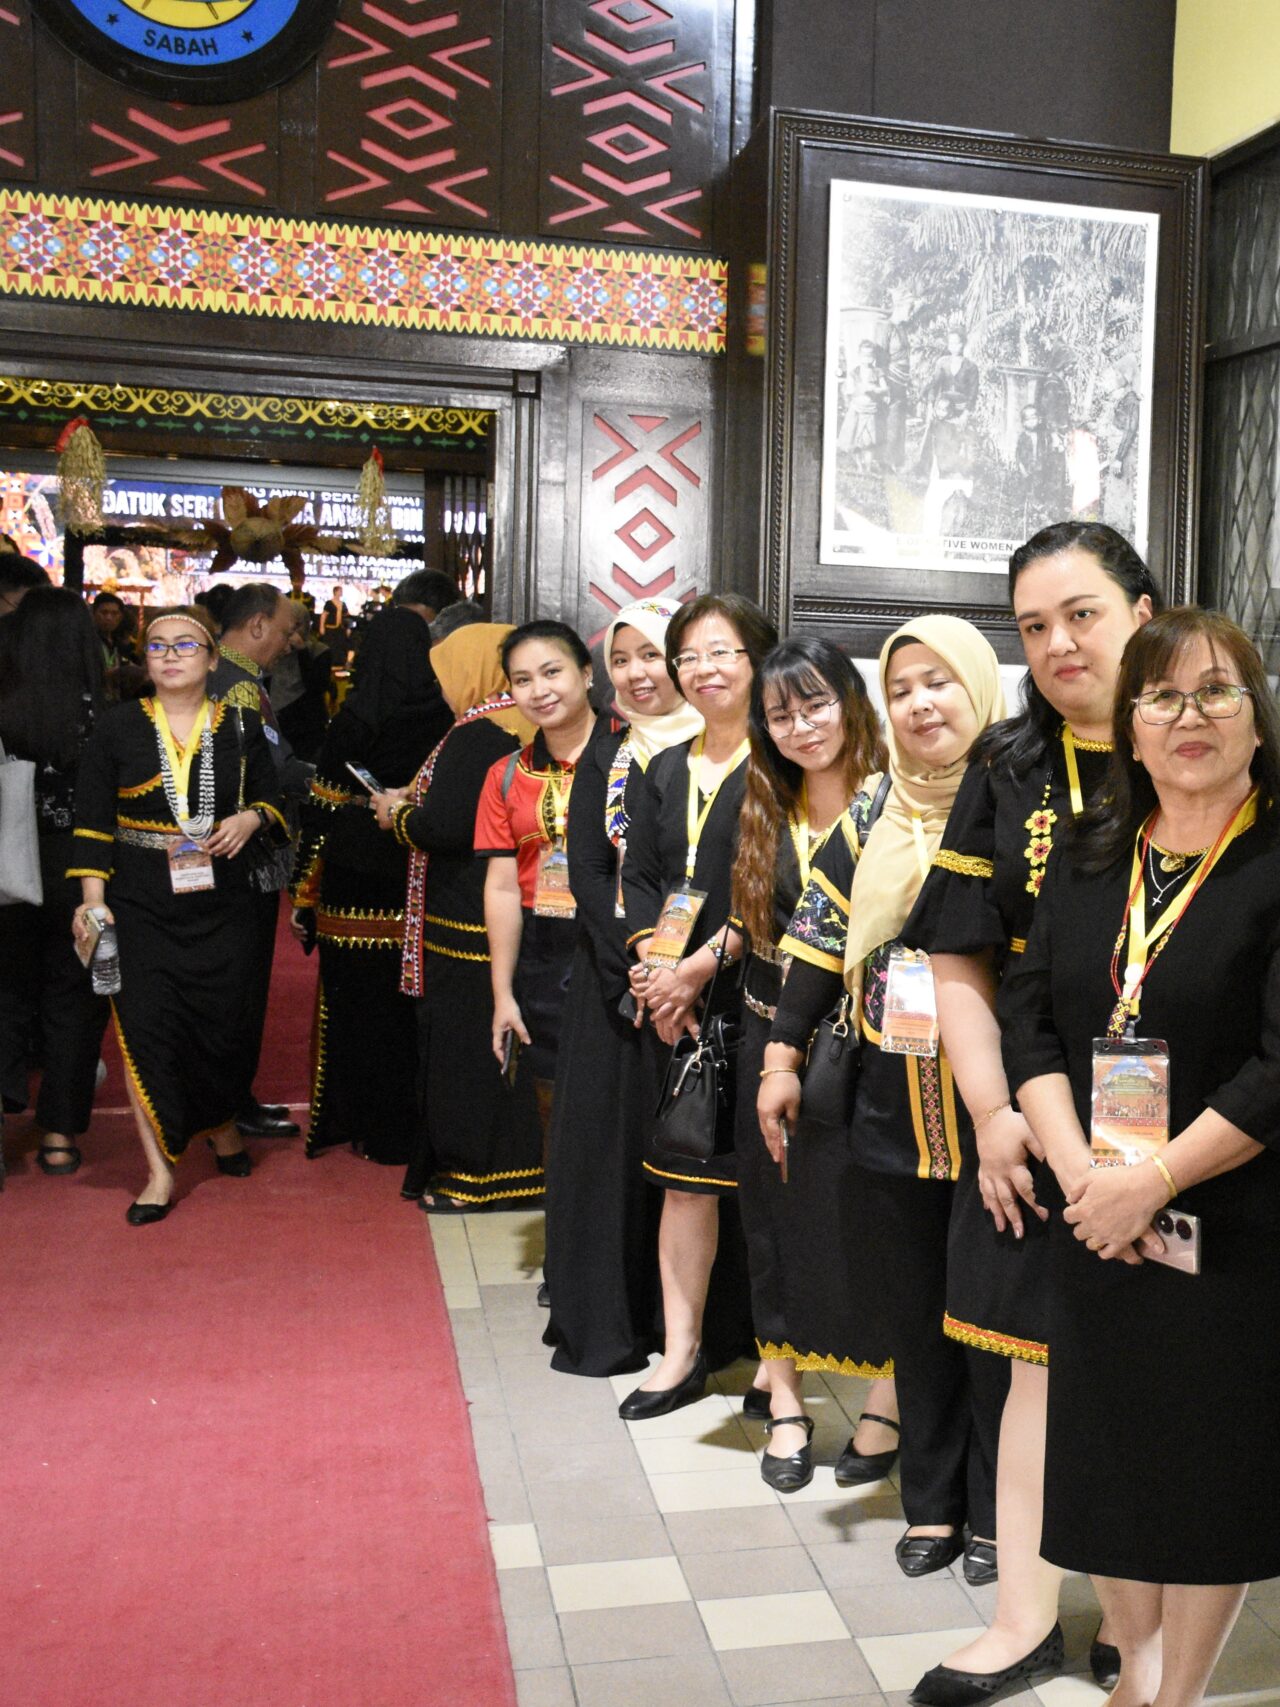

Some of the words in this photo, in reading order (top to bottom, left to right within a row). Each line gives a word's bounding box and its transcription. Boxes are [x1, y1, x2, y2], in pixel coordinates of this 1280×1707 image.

[143, 29, 219, 56] SABAH
[102, 490, 167, 517] DATUK
[170, 494, 215, 519] SERI
